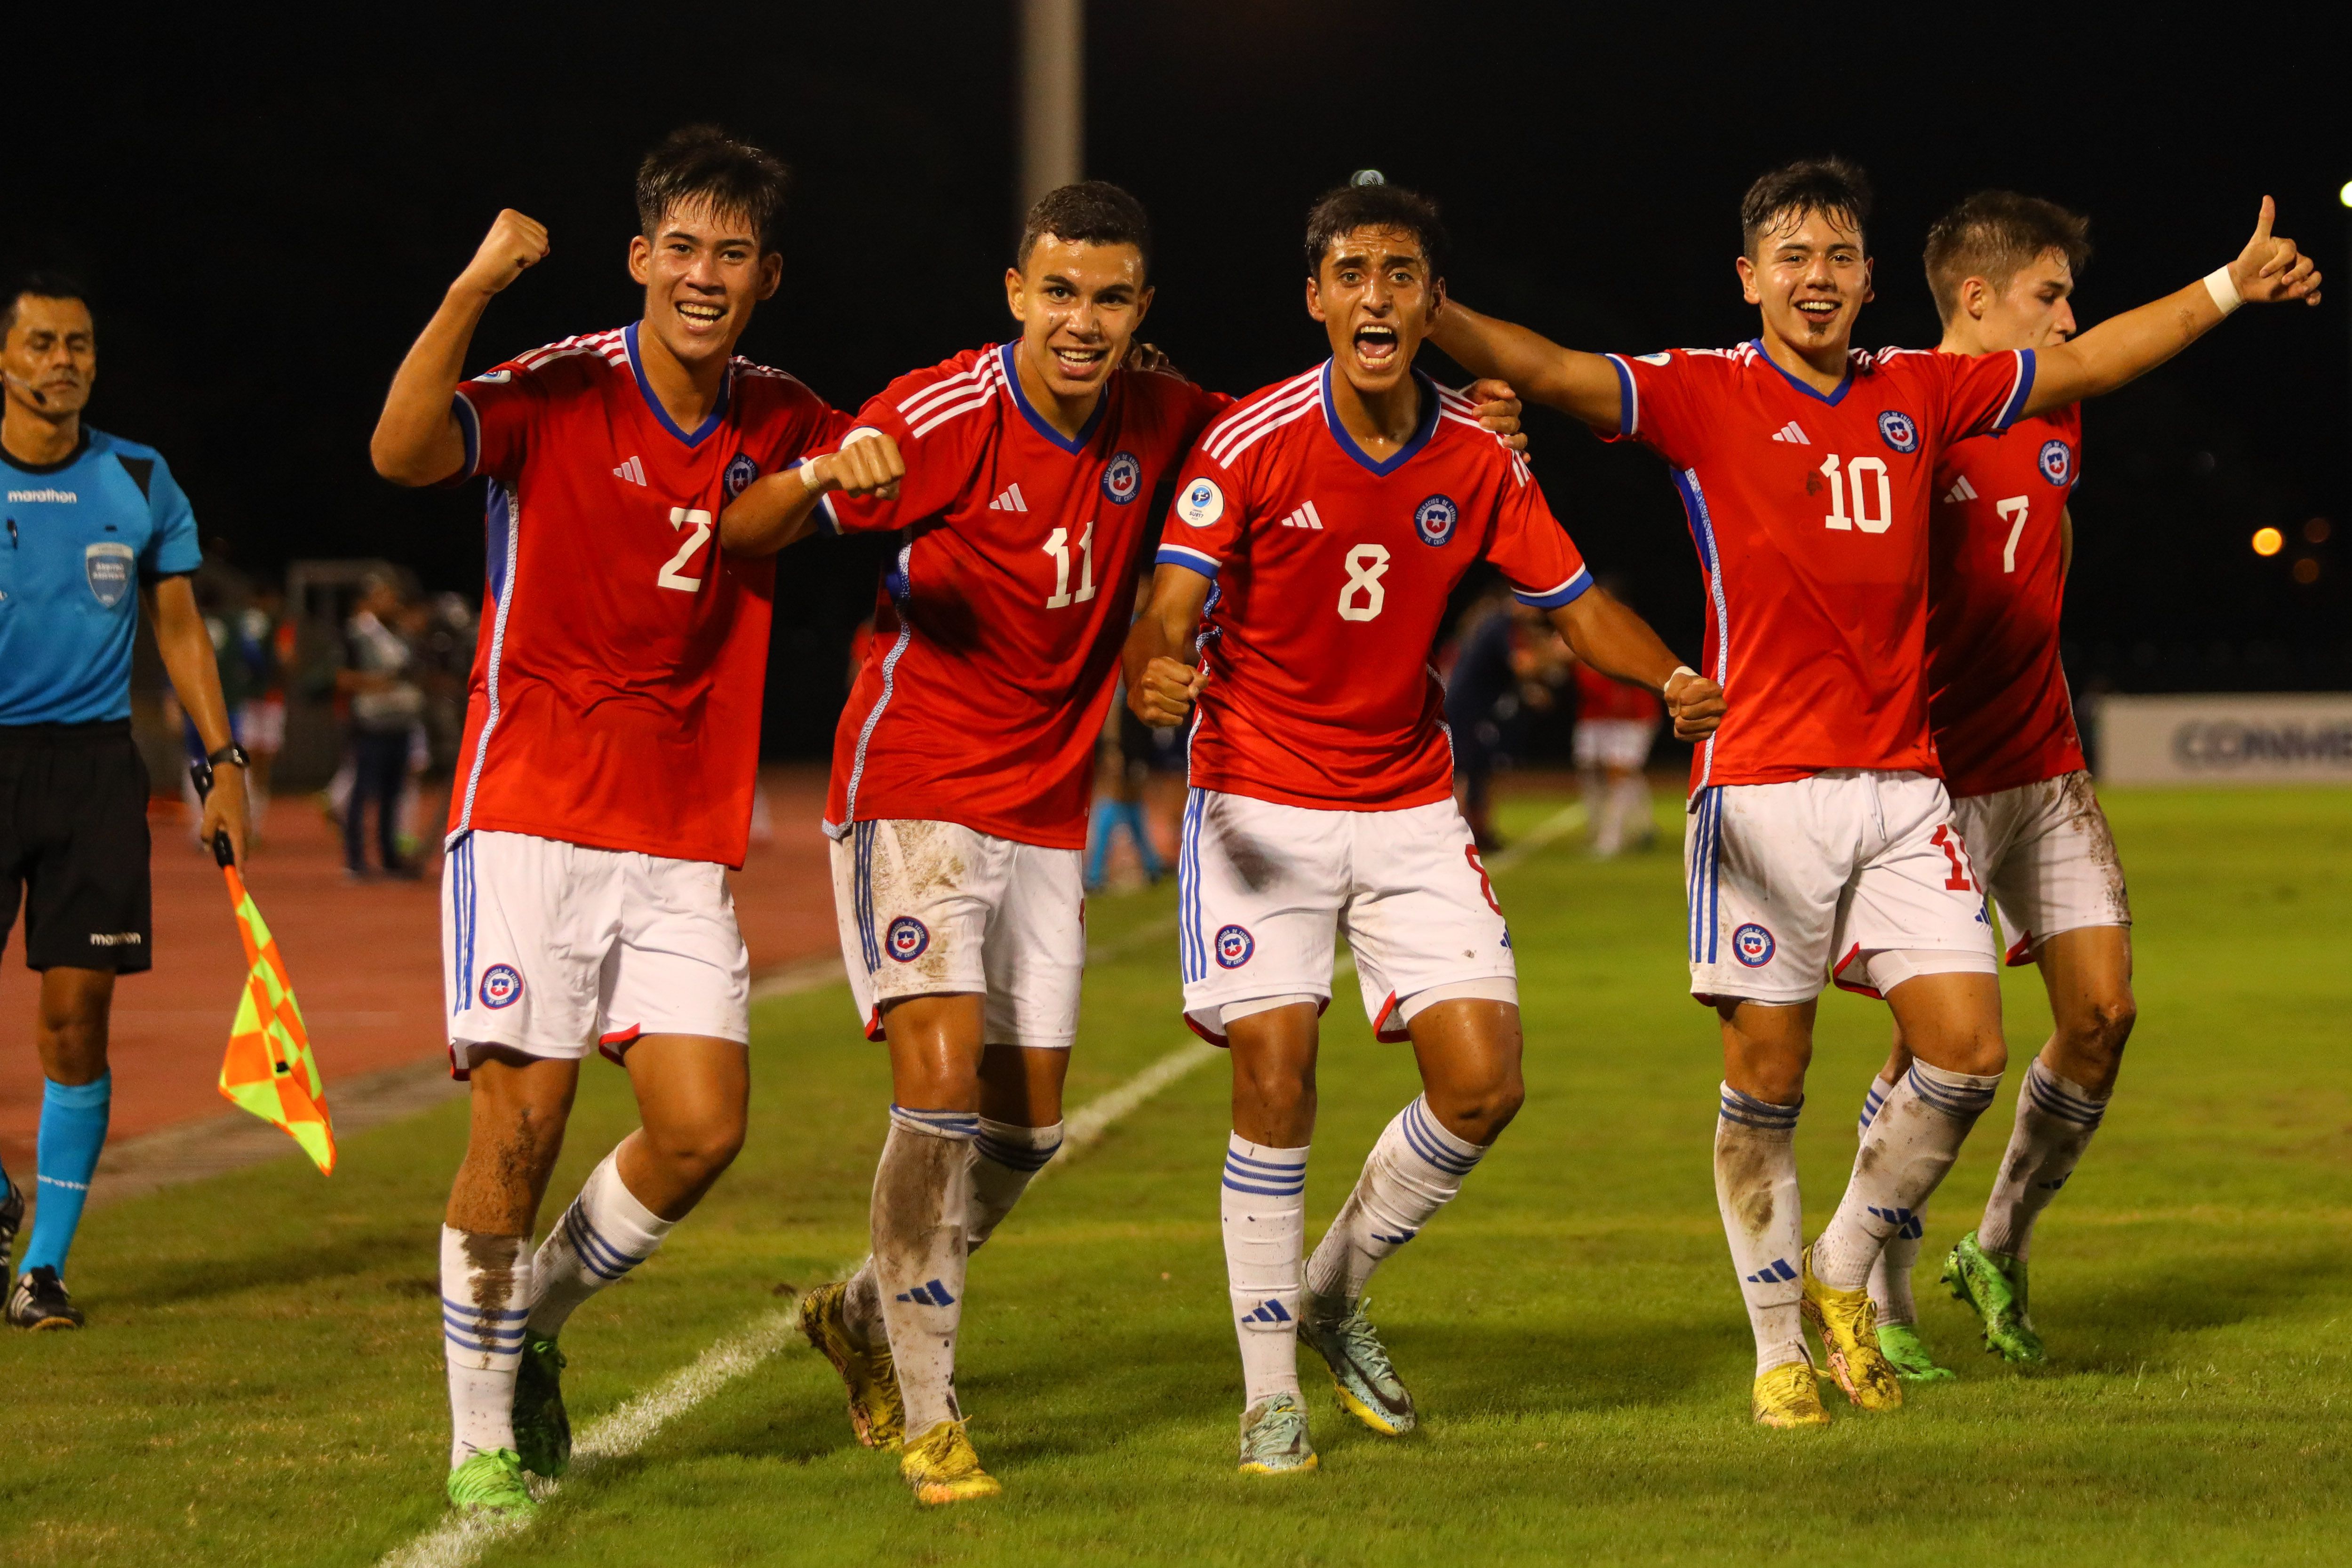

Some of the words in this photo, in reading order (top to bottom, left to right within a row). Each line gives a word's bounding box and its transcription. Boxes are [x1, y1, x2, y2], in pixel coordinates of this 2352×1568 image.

[8, 488, 77, 504] marathon
[1416, 498, 1439, 519] FEDERACION
[1819, 454, 1892, 533] 10
[658, 507, 711, 592] 2
[1042, 521, 1096, 609] 11
[1996, 495, 2029, 573] 7
[1338, 543, 1390, 621] 8
[1233, 956, 1245, 964] CHILE
